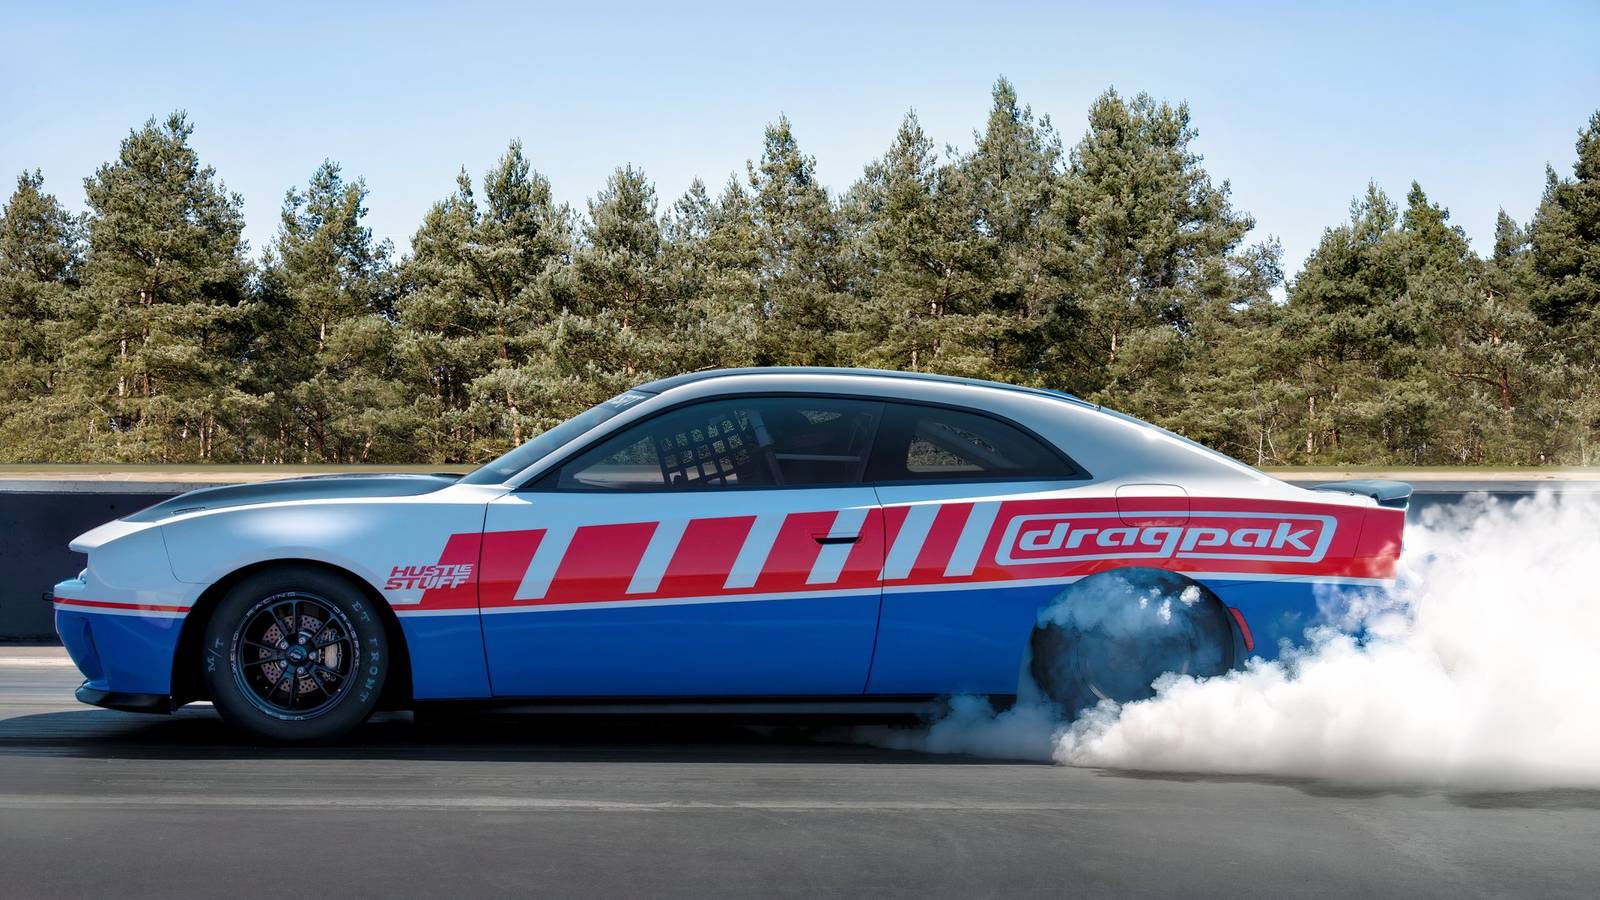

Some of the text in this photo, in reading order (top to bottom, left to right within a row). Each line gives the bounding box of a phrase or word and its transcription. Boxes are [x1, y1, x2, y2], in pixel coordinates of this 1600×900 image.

[1018, 522, 1316, 559] dragpak
[384, 576, 469, 590] STUFF
[390, 564, 474, 577] HUSTLE
[230, 632, 239, 673] WELD
[246, 592, 296, 617] RACING
[207, 638, 224, 673] M/T
[360, 638, 380, 703] FRONT
